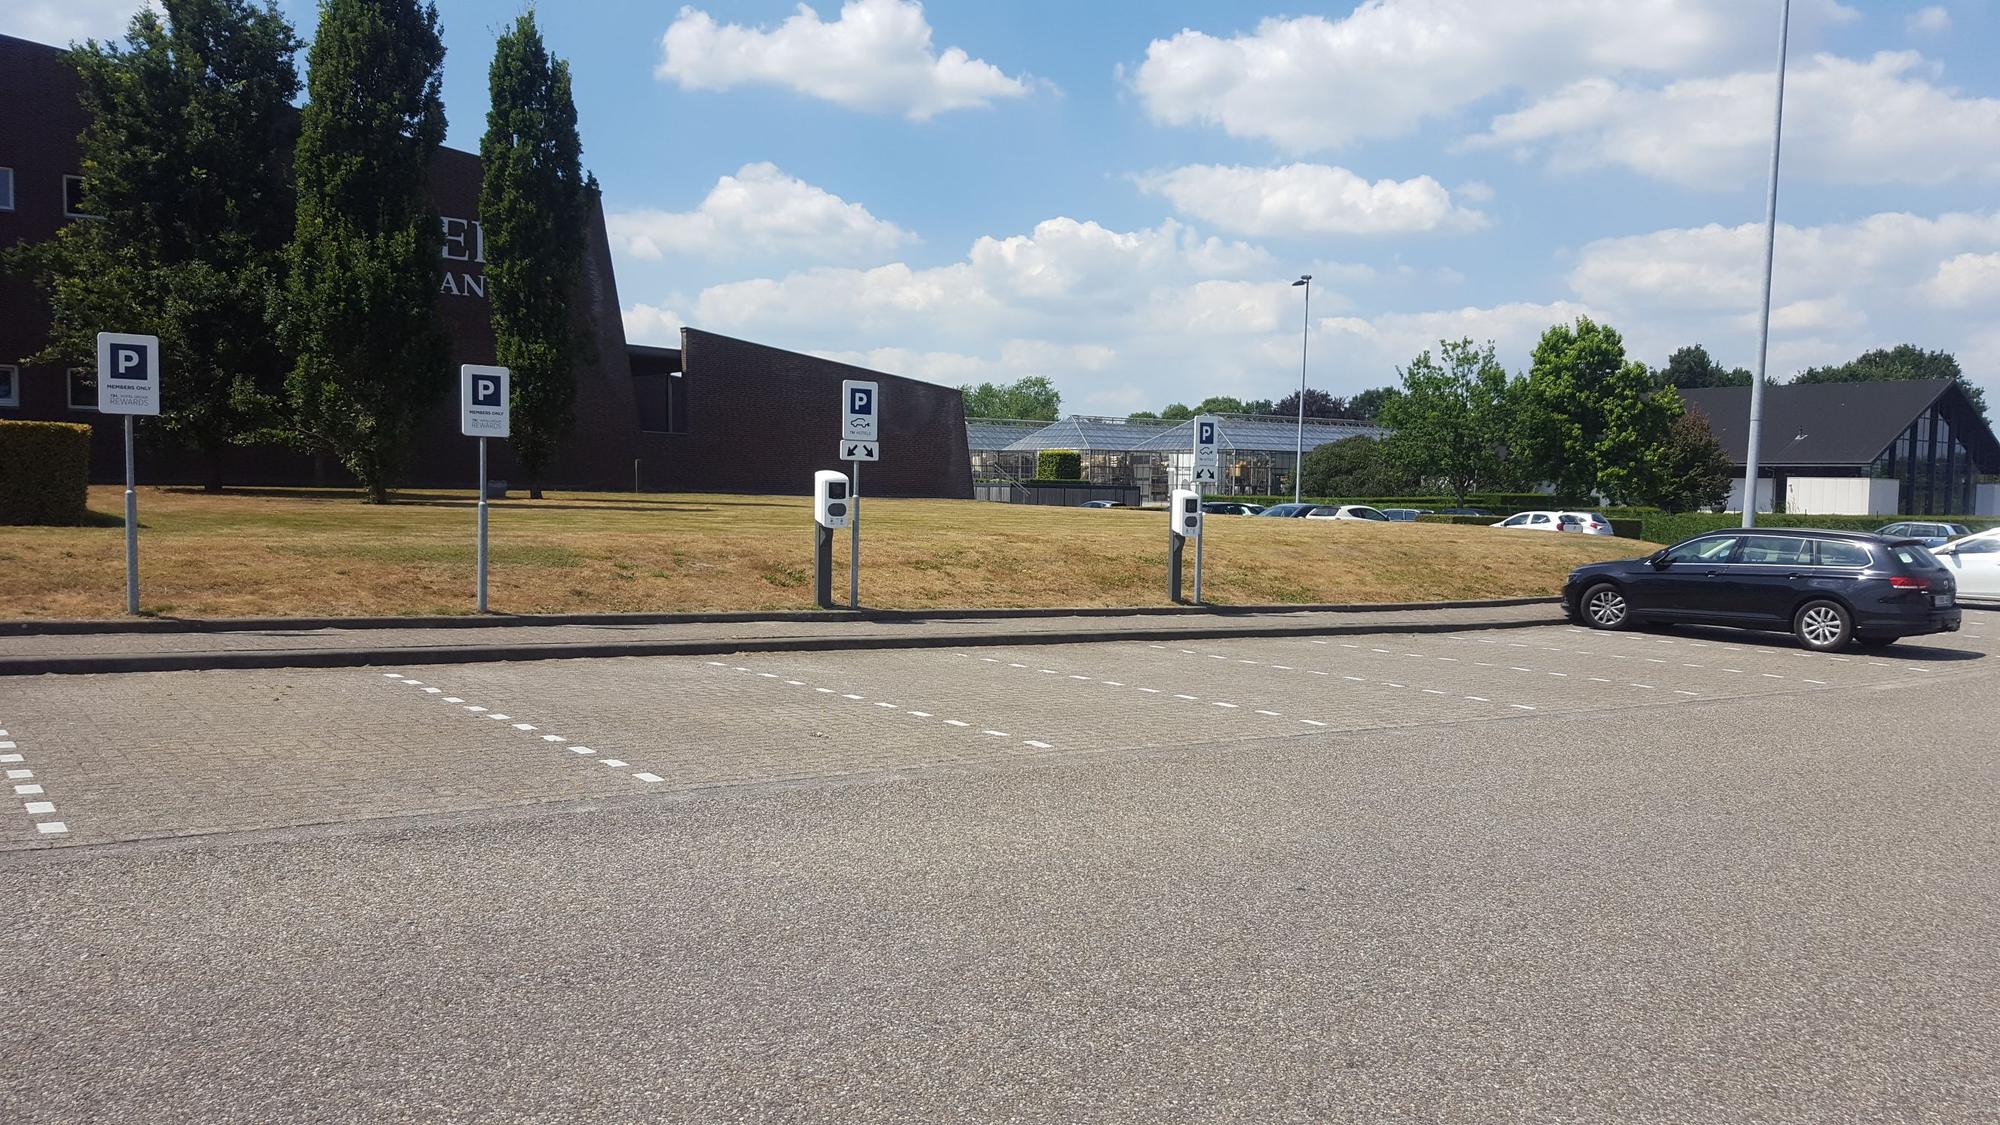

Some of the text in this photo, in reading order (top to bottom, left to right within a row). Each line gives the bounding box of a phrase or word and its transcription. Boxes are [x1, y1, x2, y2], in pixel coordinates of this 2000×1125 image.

[118, 349, 139, 373] P
[478, 379, 495, 401] P
[110, 398, 149, 406] REWARDS
[855, 392, 867, 410] P
[1203, 426, 1211, 440] P
